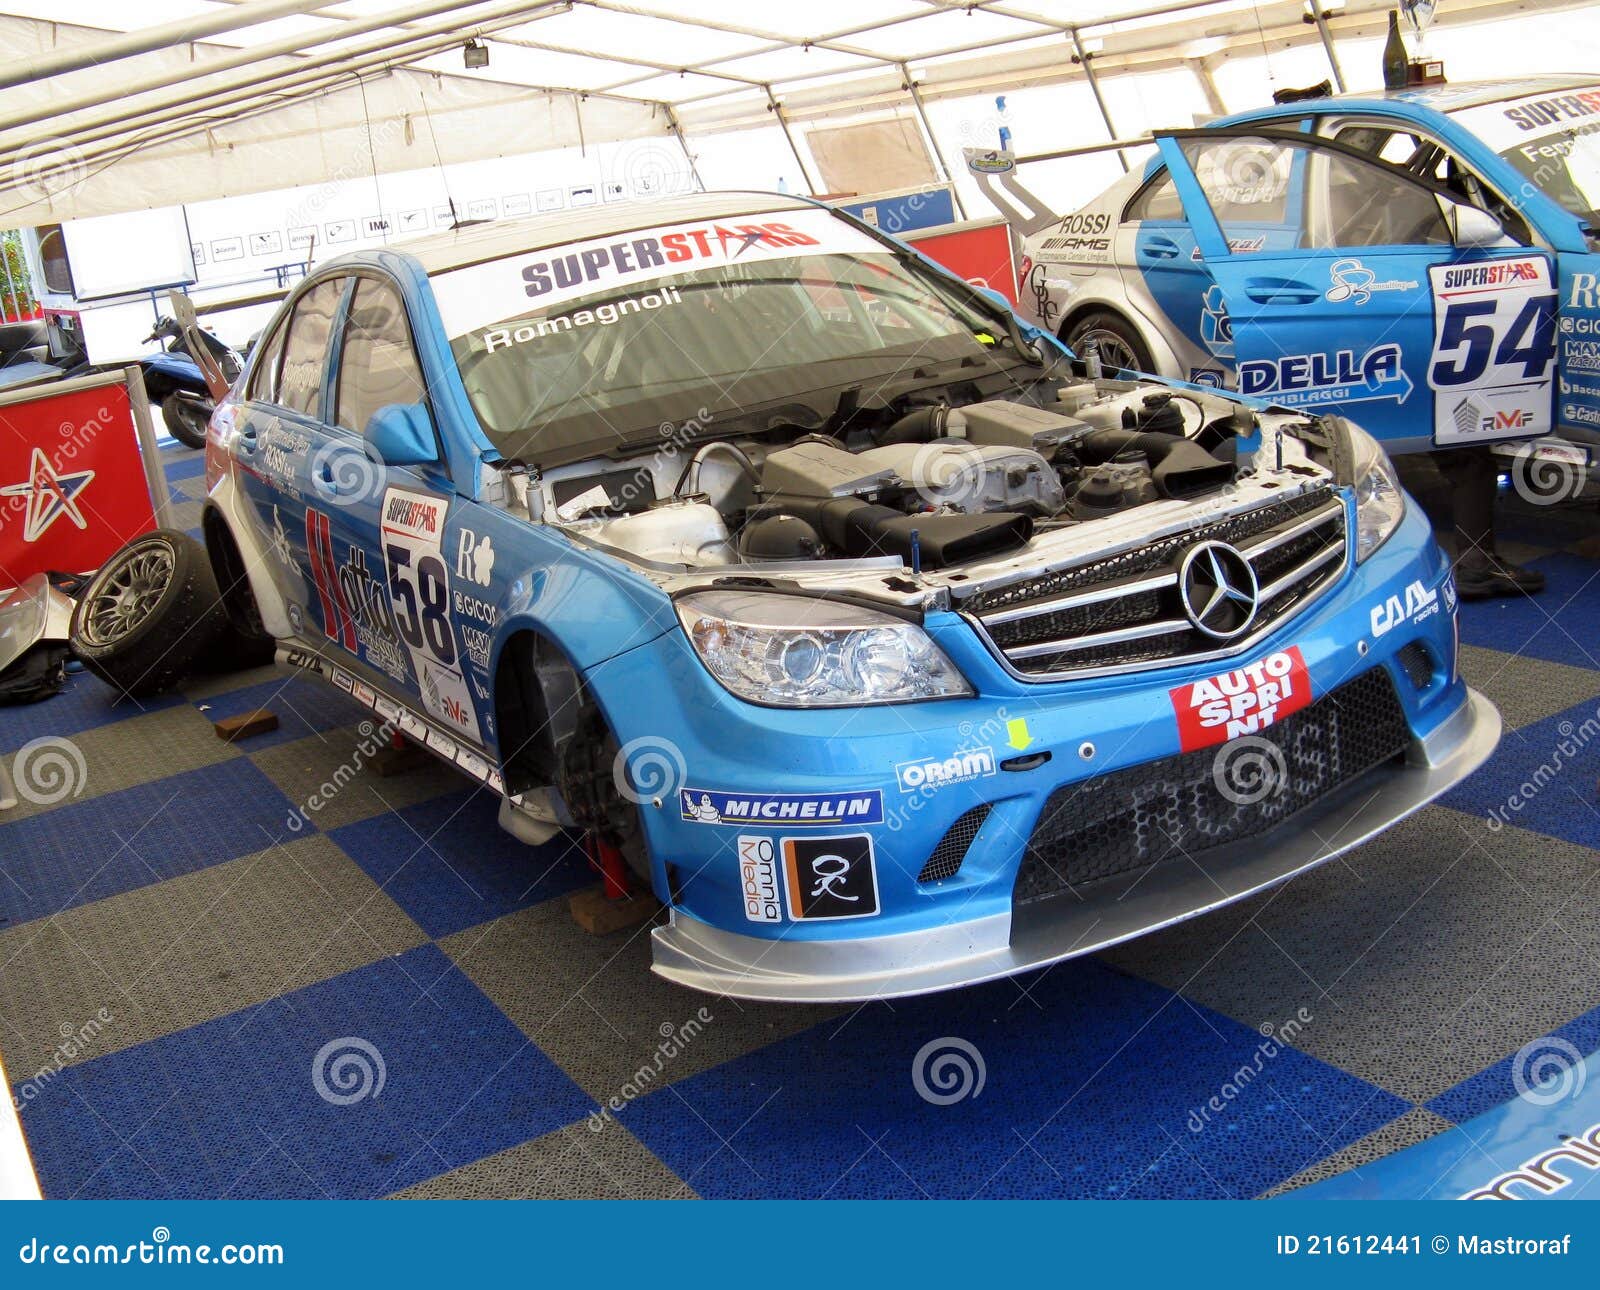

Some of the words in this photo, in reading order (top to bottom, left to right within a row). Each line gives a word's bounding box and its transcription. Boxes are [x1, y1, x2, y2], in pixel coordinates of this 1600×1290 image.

[369, 220, 390, 232] IMA
[1059, 214, 1111, 234] ROSSI
[521, 222, 821, 298] SUPERSTARS
[1061, 238, 1112, 250] AMG
[1443, 262, 1539, 289] SUPERSTARS
[484, 286, 683, 354] Romagnoli
[1433, 296, 1558, 387] 54
[1239, 343, 1401, 395] DELLA
[1482, 409, 1534, 431] RMF
[386, 497, 437, 534] SUPERSTARS
[386, 543, 457, 666] 58
[1413, 602, 1439, 625] racing
[1190, 653, 1293, 708] AUTO
[1199, 676, 1293, 728] SPRI
[1226, 704, 1278, 741] NT
[903, 753, 991, 787] ORAM
[725, 798, 872, 818] MICHELIN
[740, 841, 762, 917] Media
[757, 839, 781, 920] Omnia
